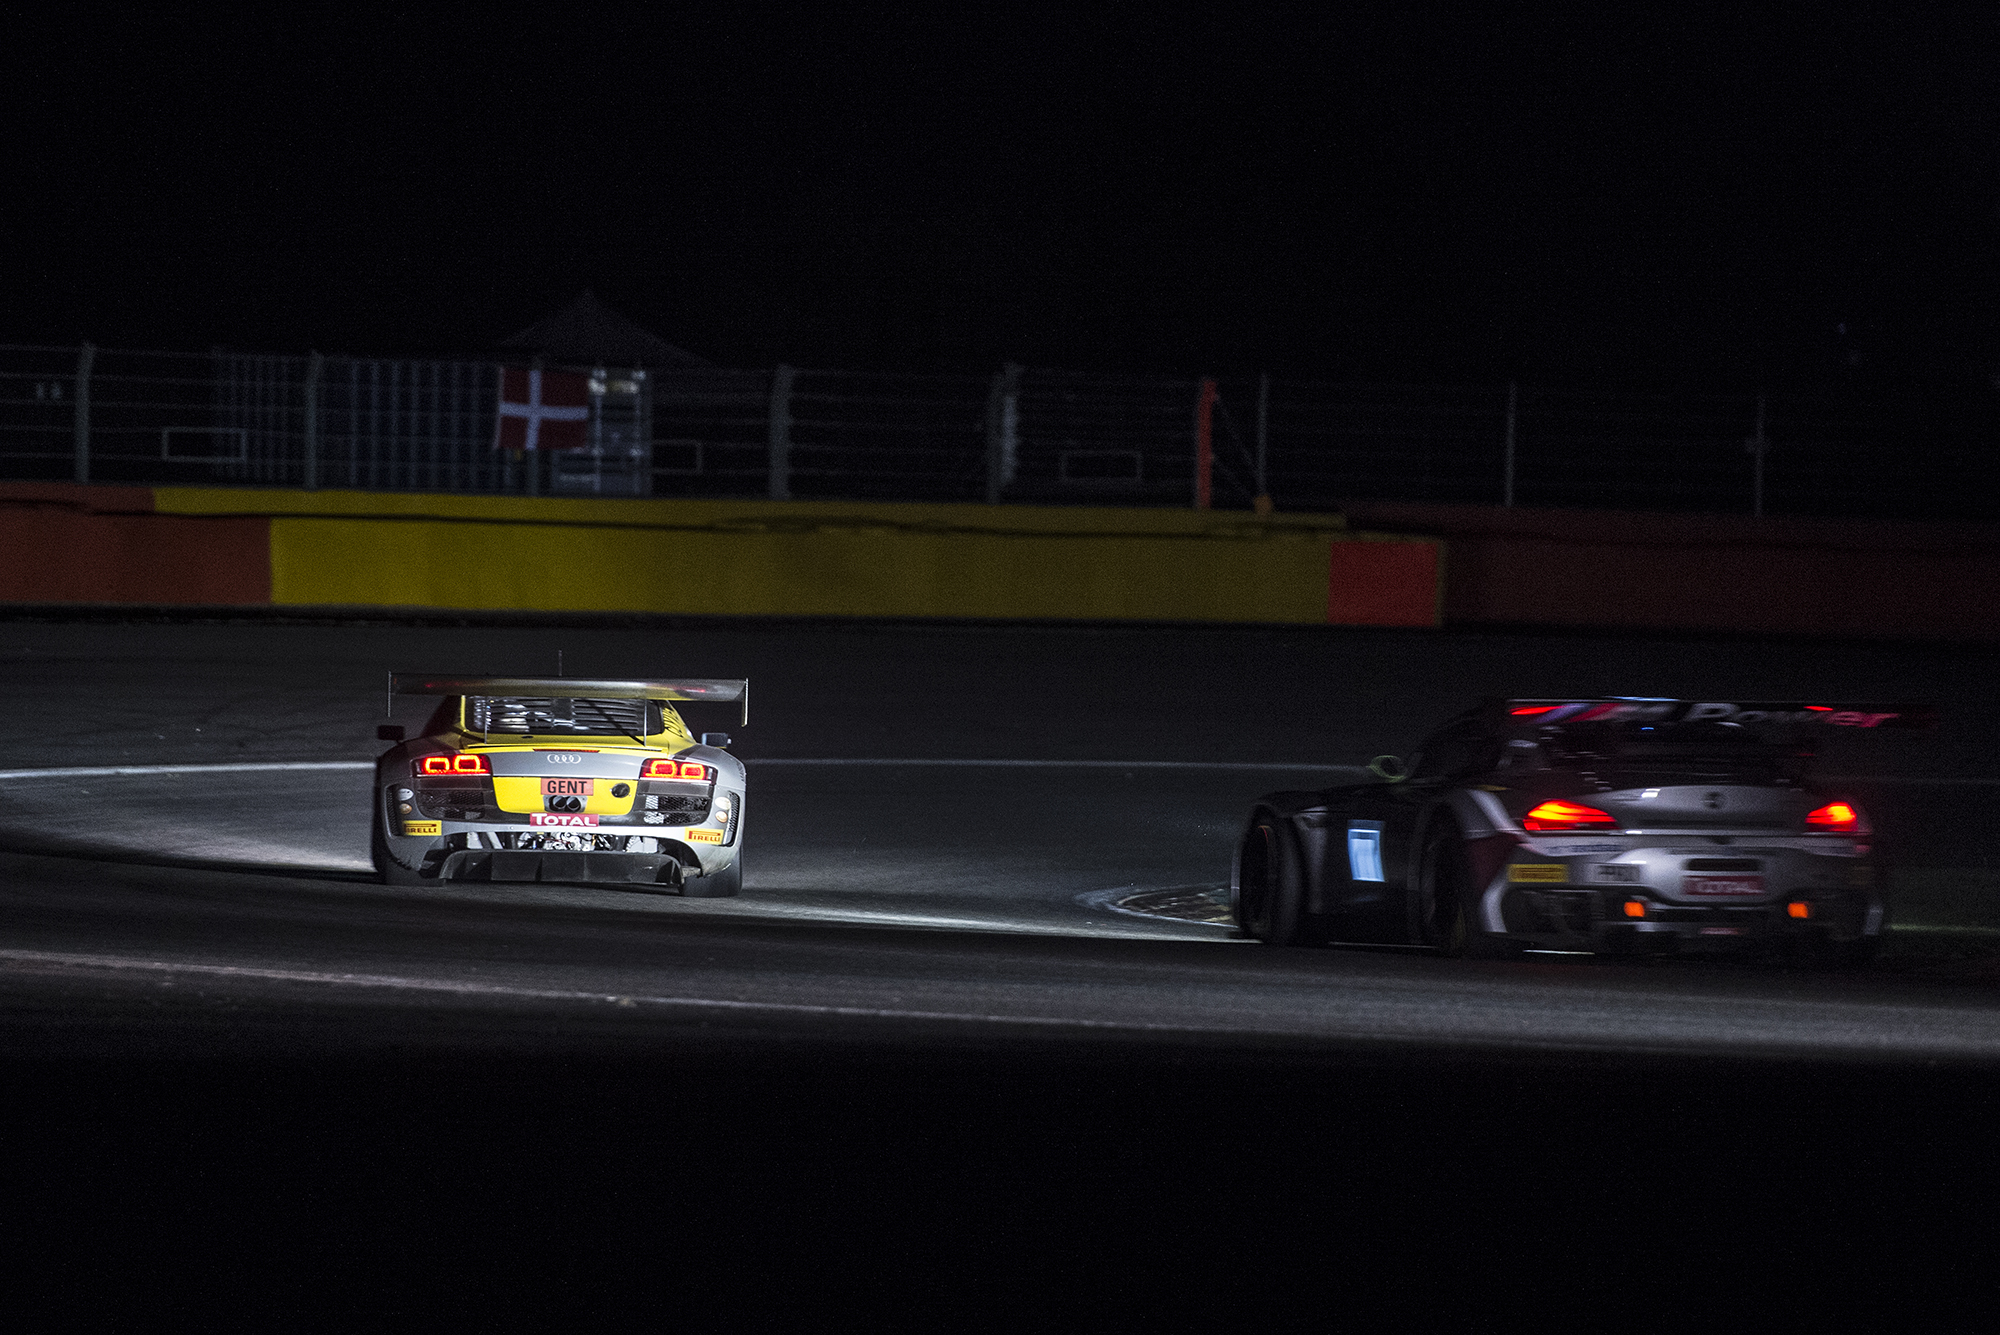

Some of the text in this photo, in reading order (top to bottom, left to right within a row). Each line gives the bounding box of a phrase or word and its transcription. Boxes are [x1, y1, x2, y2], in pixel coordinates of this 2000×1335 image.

[547, 780, 587, 794] GENT
[531, 813, 597, 827] TOTAL
[688, 830, 721, 842] PIRELLI
